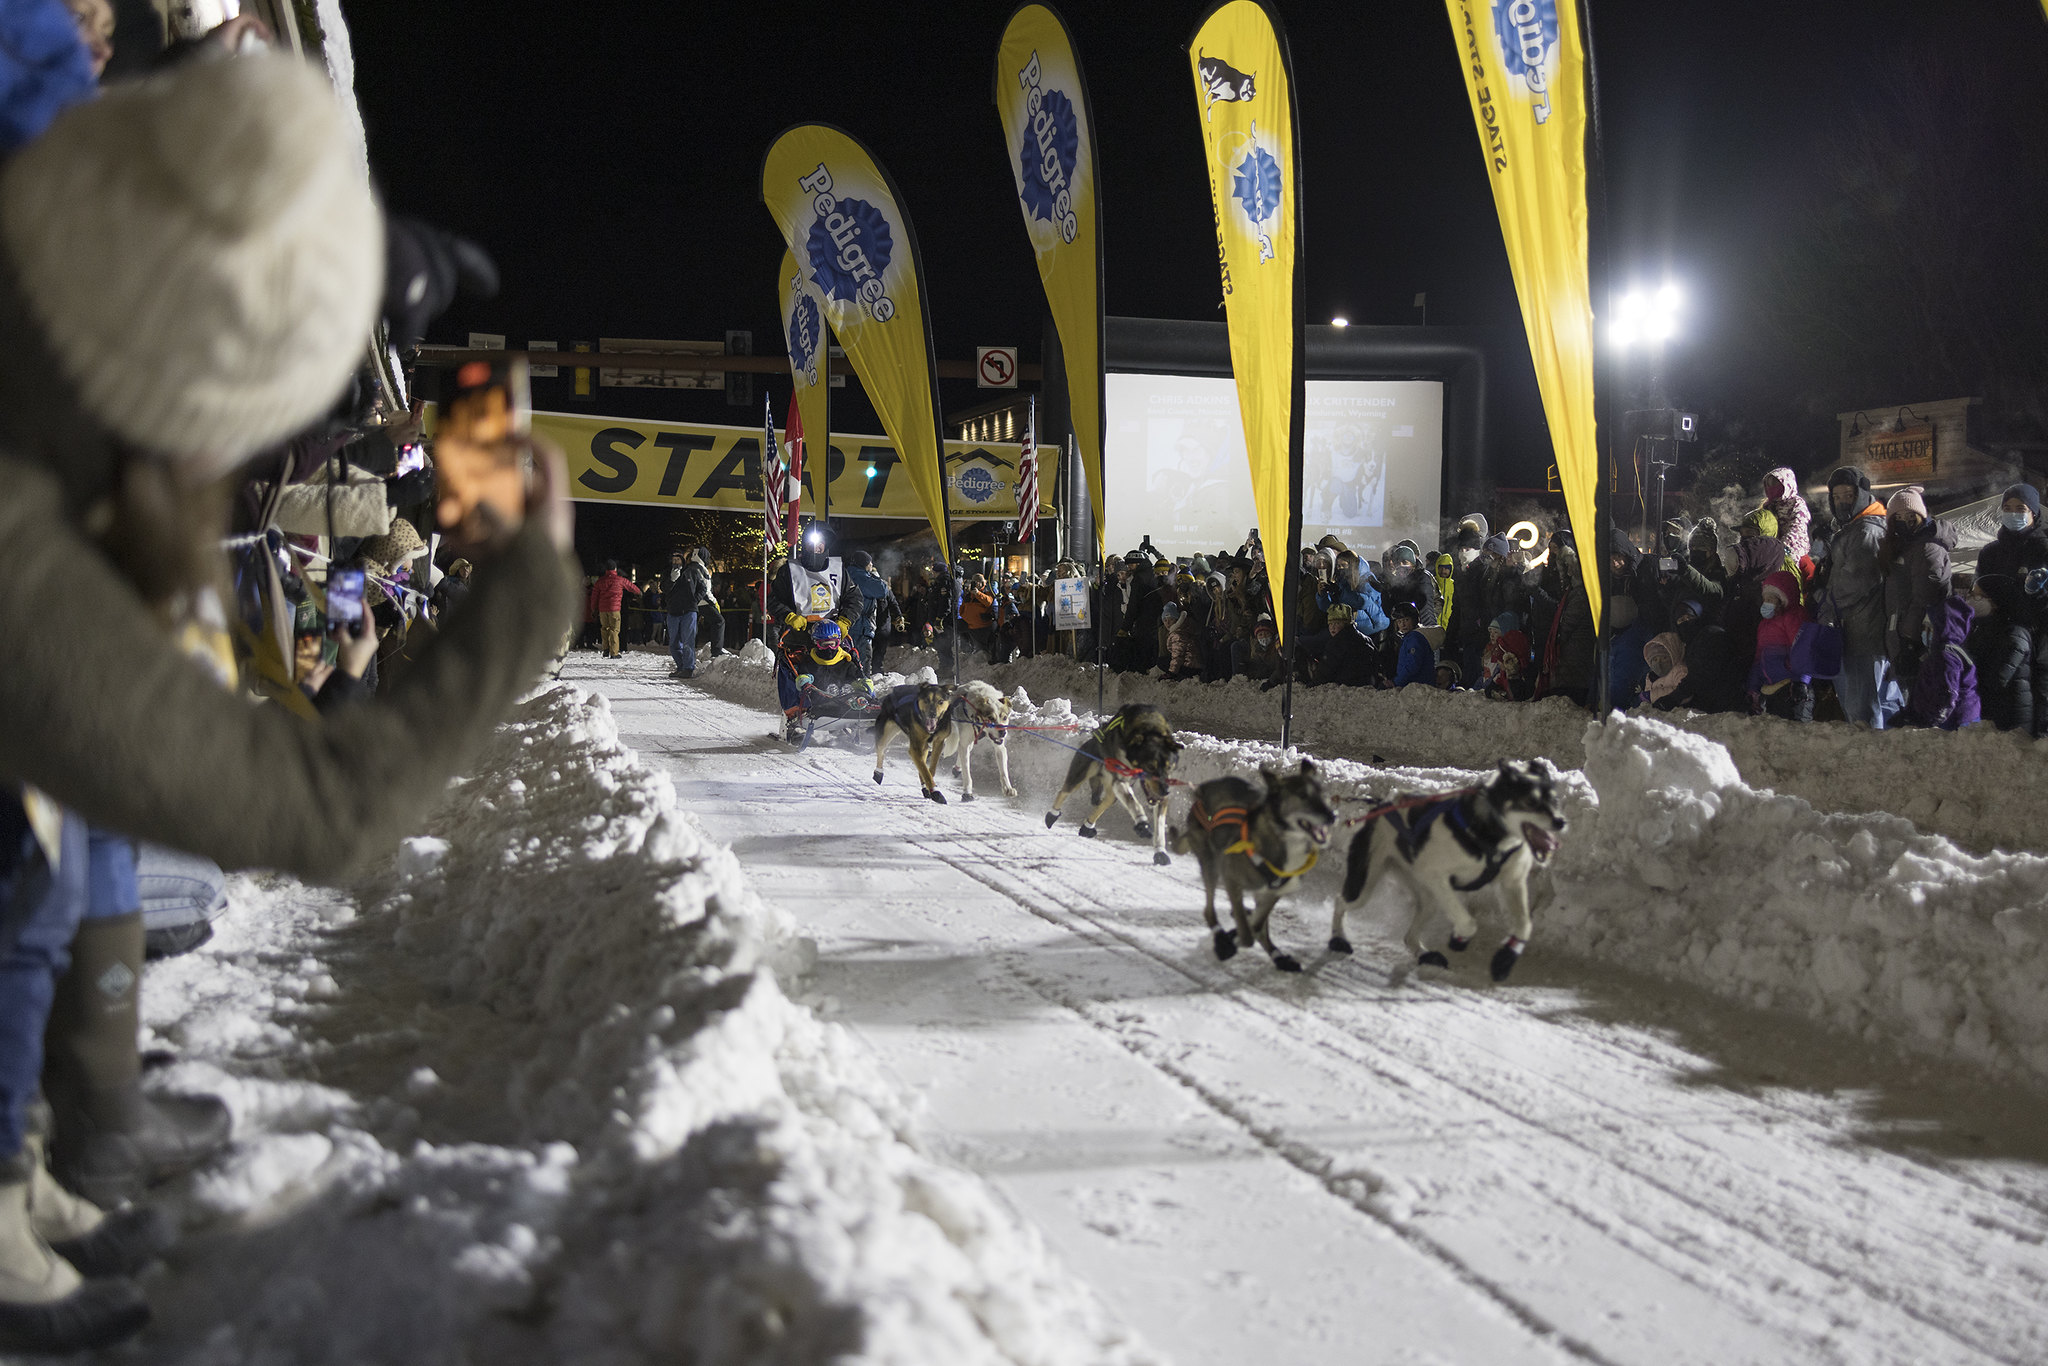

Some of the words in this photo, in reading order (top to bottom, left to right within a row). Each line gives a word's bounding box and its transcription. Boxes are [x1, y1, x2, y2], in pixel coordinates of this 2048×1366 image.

[1018, 49, 1077, 244] Pedigree
[798, 162, 895, 322] Pedigree
[790, 268, 818, 388] Pedigree
[1186, 395, 1232, 405] ADKINS
[1323, 397, 1396, 406] CRITTENDEN
[1348, 409, 1387, 419] Wyoming
[1868, 442, 1899, 460] STAGE
[1902, 439, 1930, 458] STOP
[947, 476, 1006, 491] Pedigree
[829, 574, 838, 586] 5
